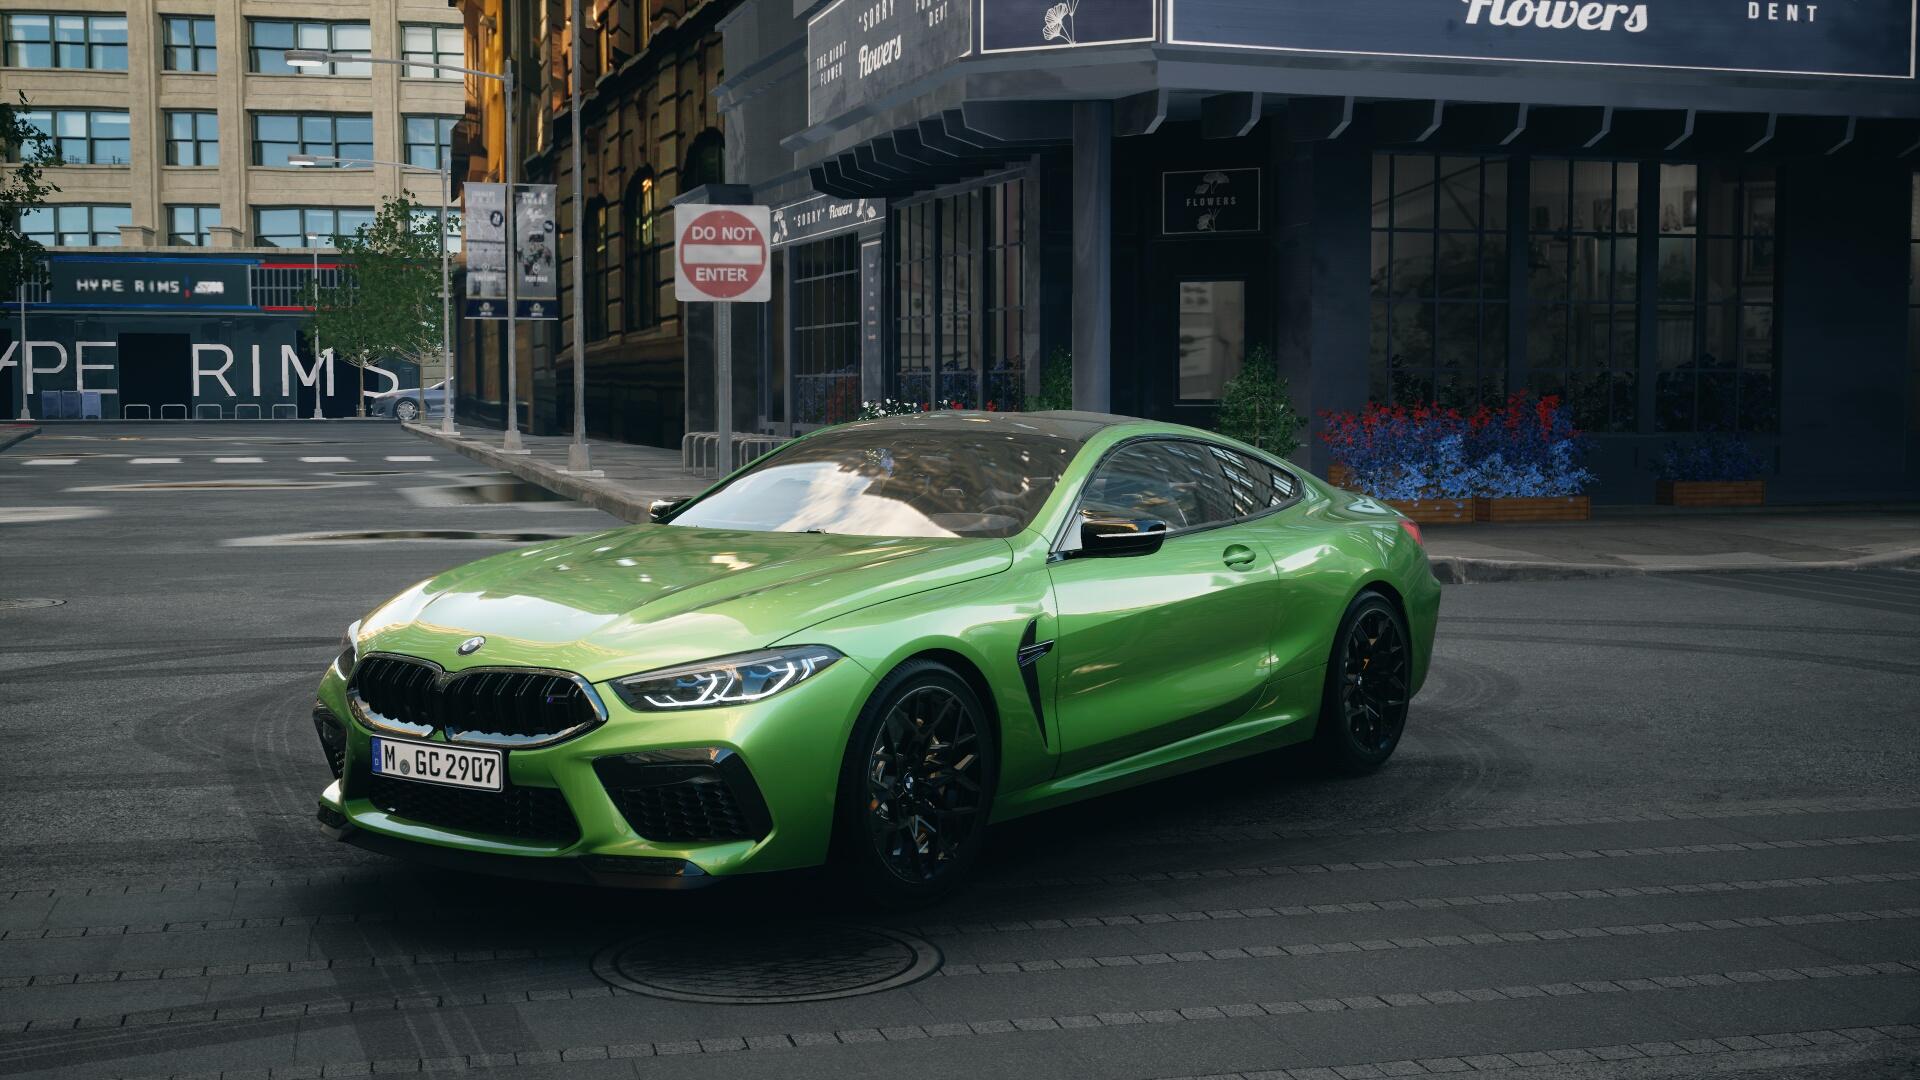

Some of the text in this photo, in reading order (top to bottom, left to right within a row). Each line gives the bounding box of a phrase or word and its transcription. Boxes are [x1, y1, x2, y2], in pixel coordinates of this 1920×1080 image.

[1748, 1, 1818, 22] DENT
[858, 34, 902, 79] Flowers
[820, 61, 842, 87] FLOWER
[1186, 196, 1236, 207] FLOWERS
[829, 203, 853, 219] Flowers
[691, 226, 756, 240] DO NOT
[695, 267, 749, 281] ENTER
[76, 279, 180, 293] HYPE RIMS
[384, 744, 496, 784] M GC 2907
